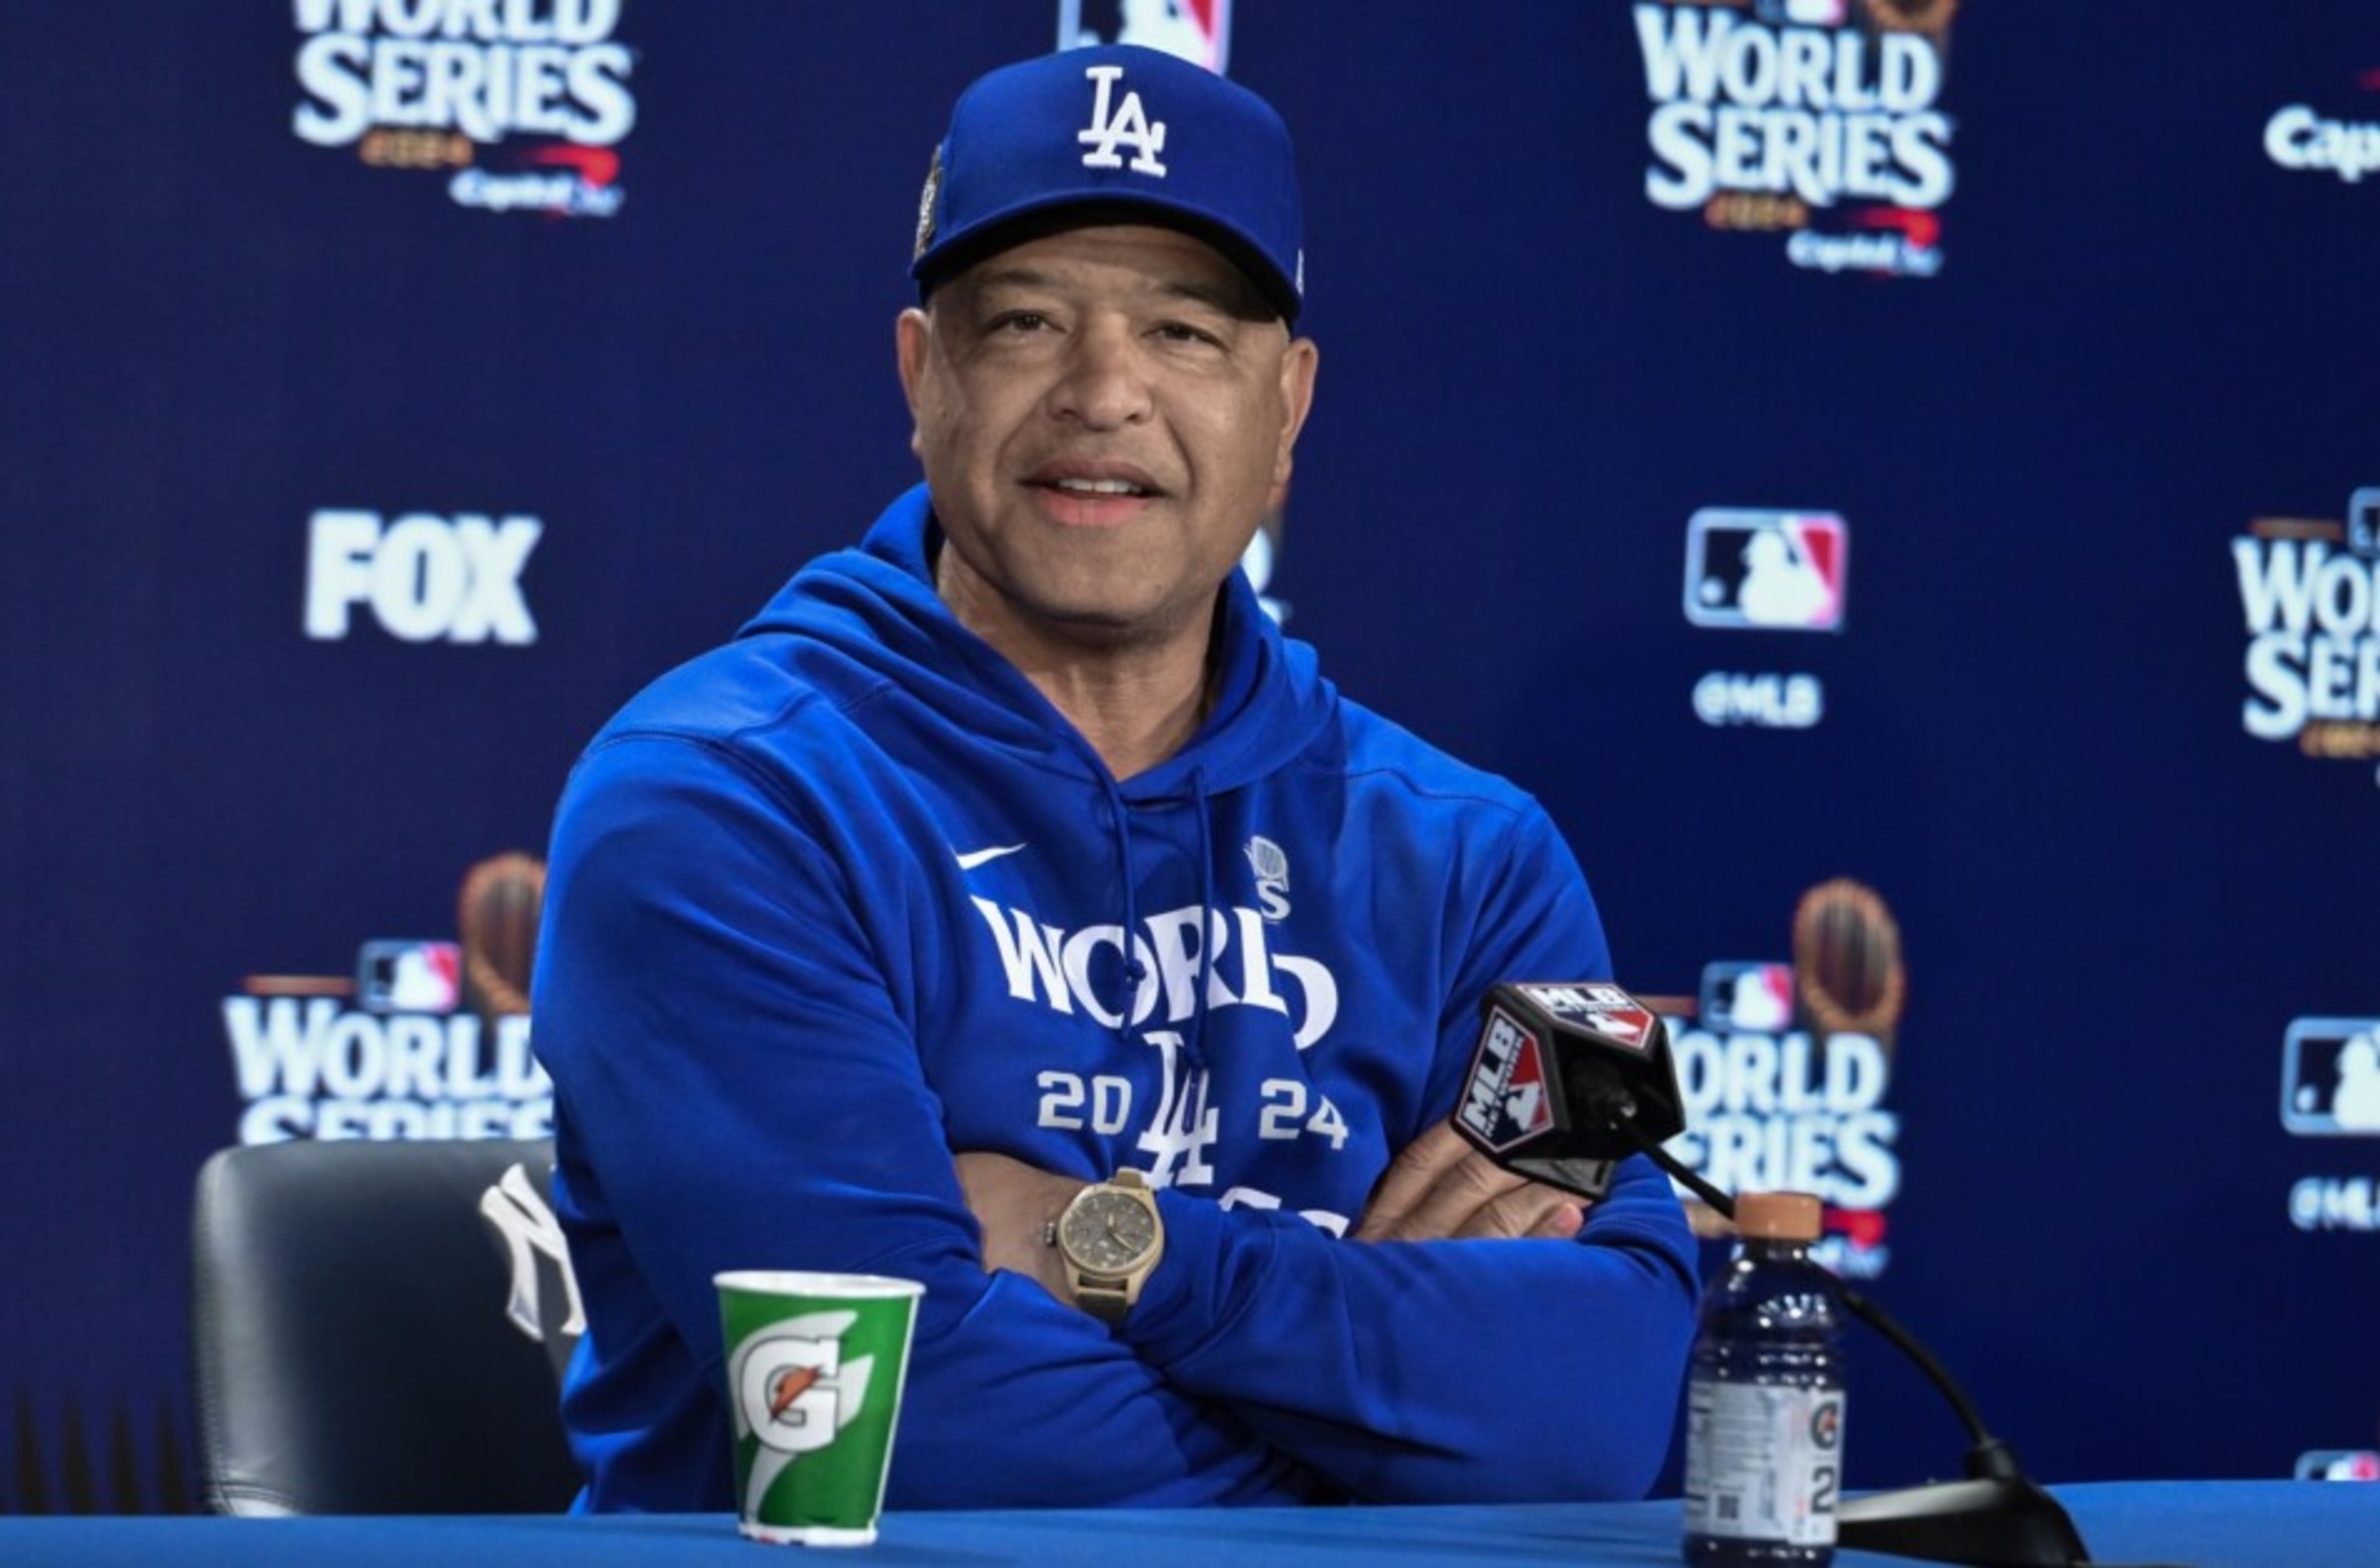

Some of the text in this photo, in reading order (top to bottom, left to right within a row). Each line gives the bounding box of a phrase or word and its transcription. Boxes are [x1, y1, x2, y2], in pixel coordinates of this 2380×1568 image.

[293, 31, 636, 146] SERIES
[1634, 3, 1940, 114] WORLD
[1078, 65, 1166, 177] LA
[1645, 100, 1954, 209] SERIES
[305, 507, 544, 645] FOX
[2231, 536, 2380, 636] WO
[970, 895, 1339, 1050] WORLD
[1526, 986, 1630, 1008] MLB
[223, 995, 556, 1102] WORLD
[1463, 1017, 1517, 1131] MLB
[1663, 1015, 1887, 1112] ORLD
[1037, 1070, 1349, 1150] 20 24
[1137, 1031, 1220, 1190] LA
[1659, 1106, 1903, 1210] ERIES
[740, 1336, 842, 1453] G
[1811, 1465, 1835, 1515] 2
